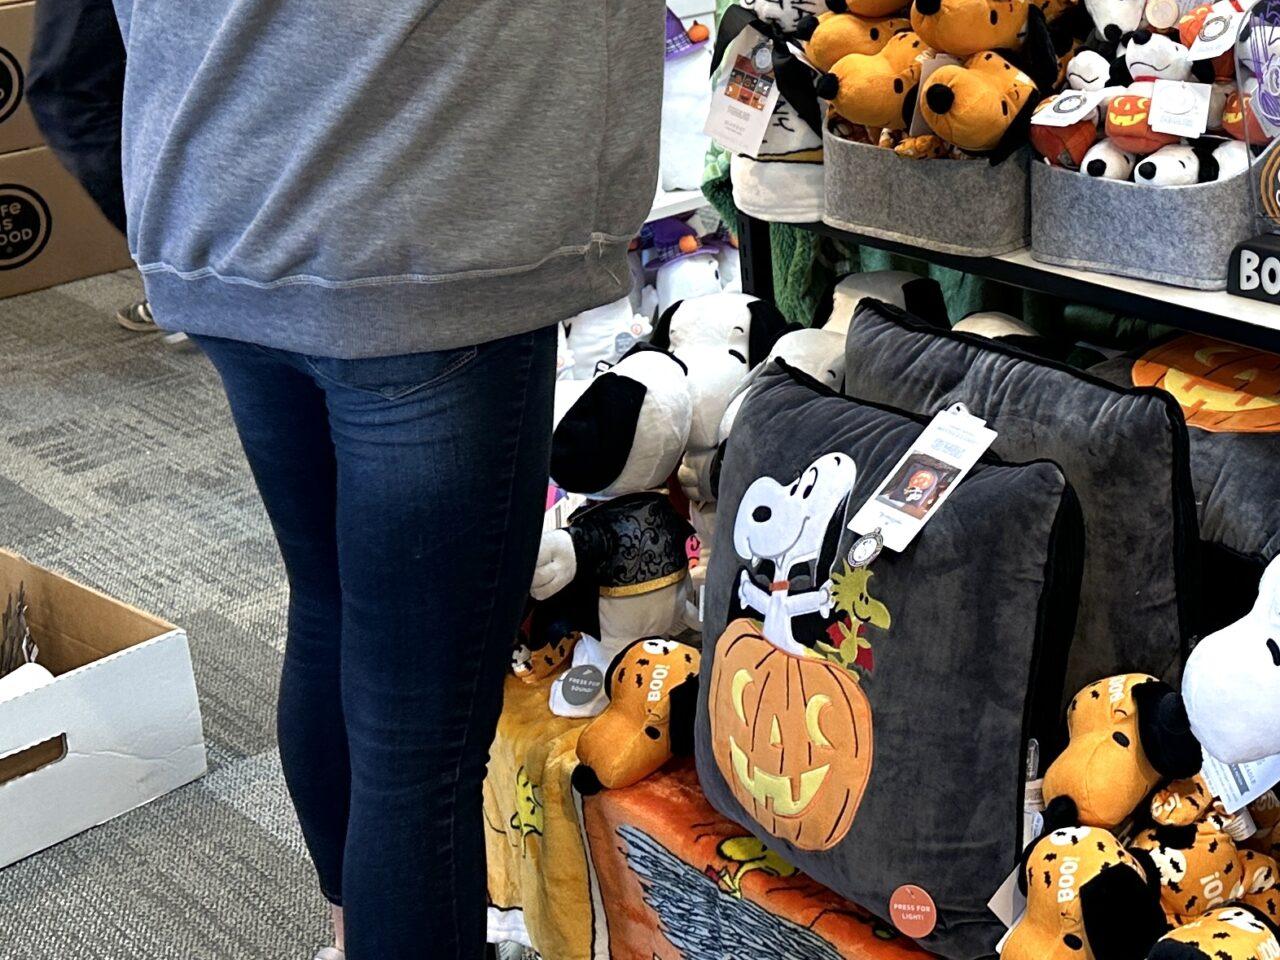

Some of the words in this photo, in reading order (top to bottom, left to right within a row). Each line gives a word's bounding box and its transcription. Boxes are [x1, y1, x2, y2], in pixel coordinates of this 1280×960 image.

[647, 664, 671, 702] BOO!
[1057, 856, 1081, 903] BOO!
[893, 903, 915, 911] PRESS
